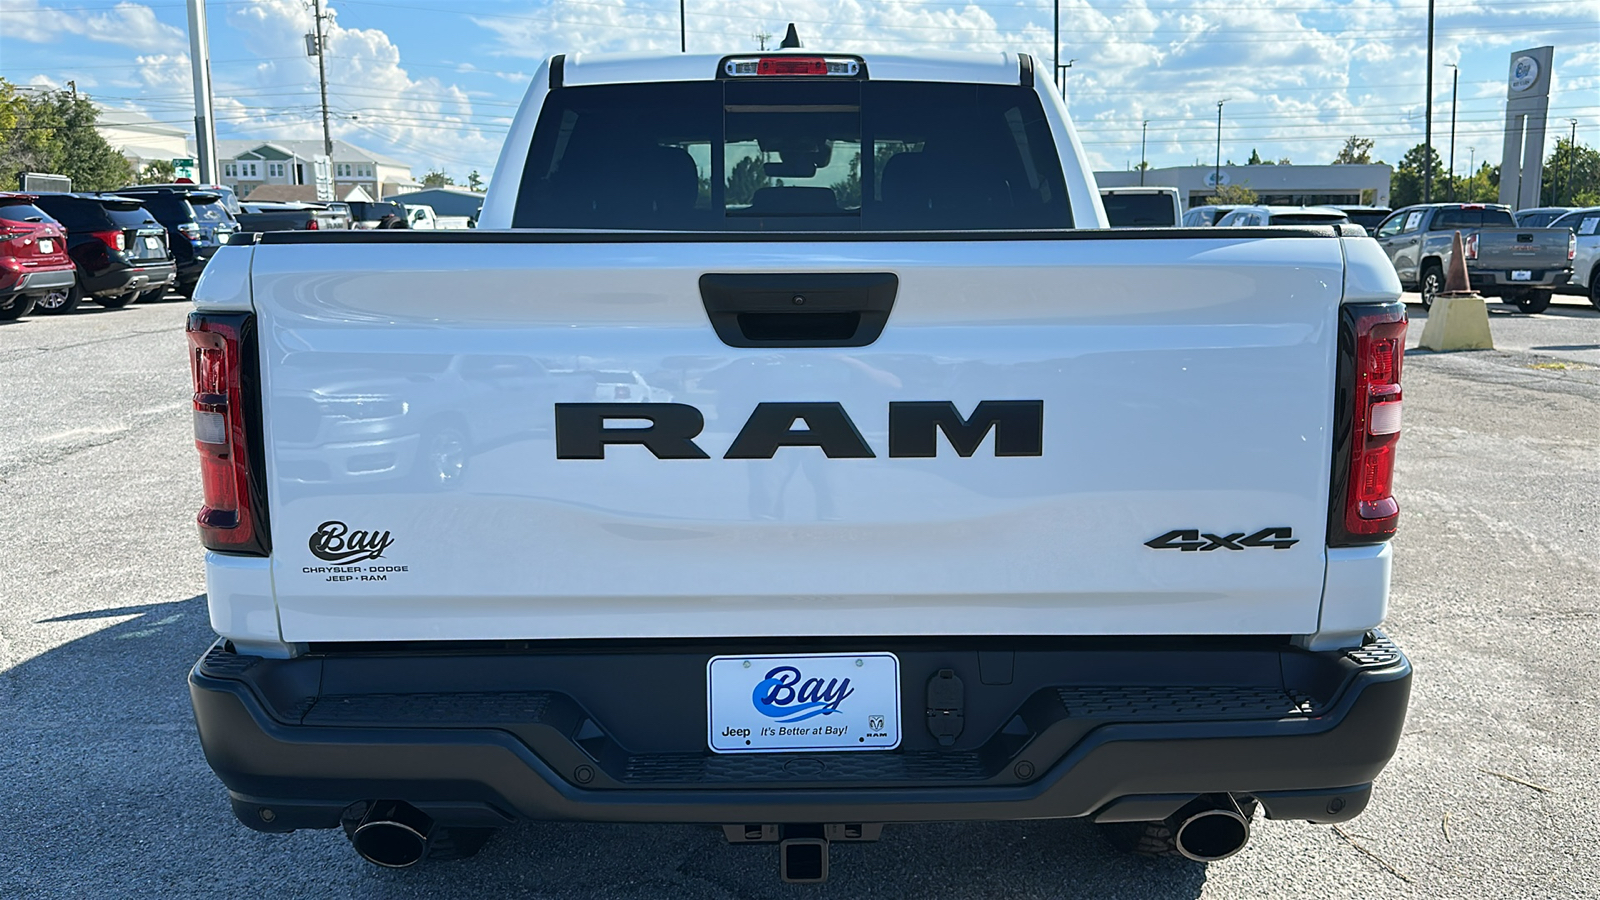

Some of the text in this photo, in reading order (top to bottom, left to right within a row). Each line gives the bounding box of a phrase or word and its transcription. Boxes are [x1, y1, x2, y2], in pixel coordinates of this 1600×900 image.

[554, 399, 1044, 460] RAM
[313, 520, 395, 561] Bay
[1143, 526, 1300, 552] 4x4
[302, 565, 409, 574] CHRYSLER DODGE
[759, 666, 855, 716] Bay
[721, 726, 751, 738] Jeep
[760, 725, 849, 737] It's Better at Bay!
